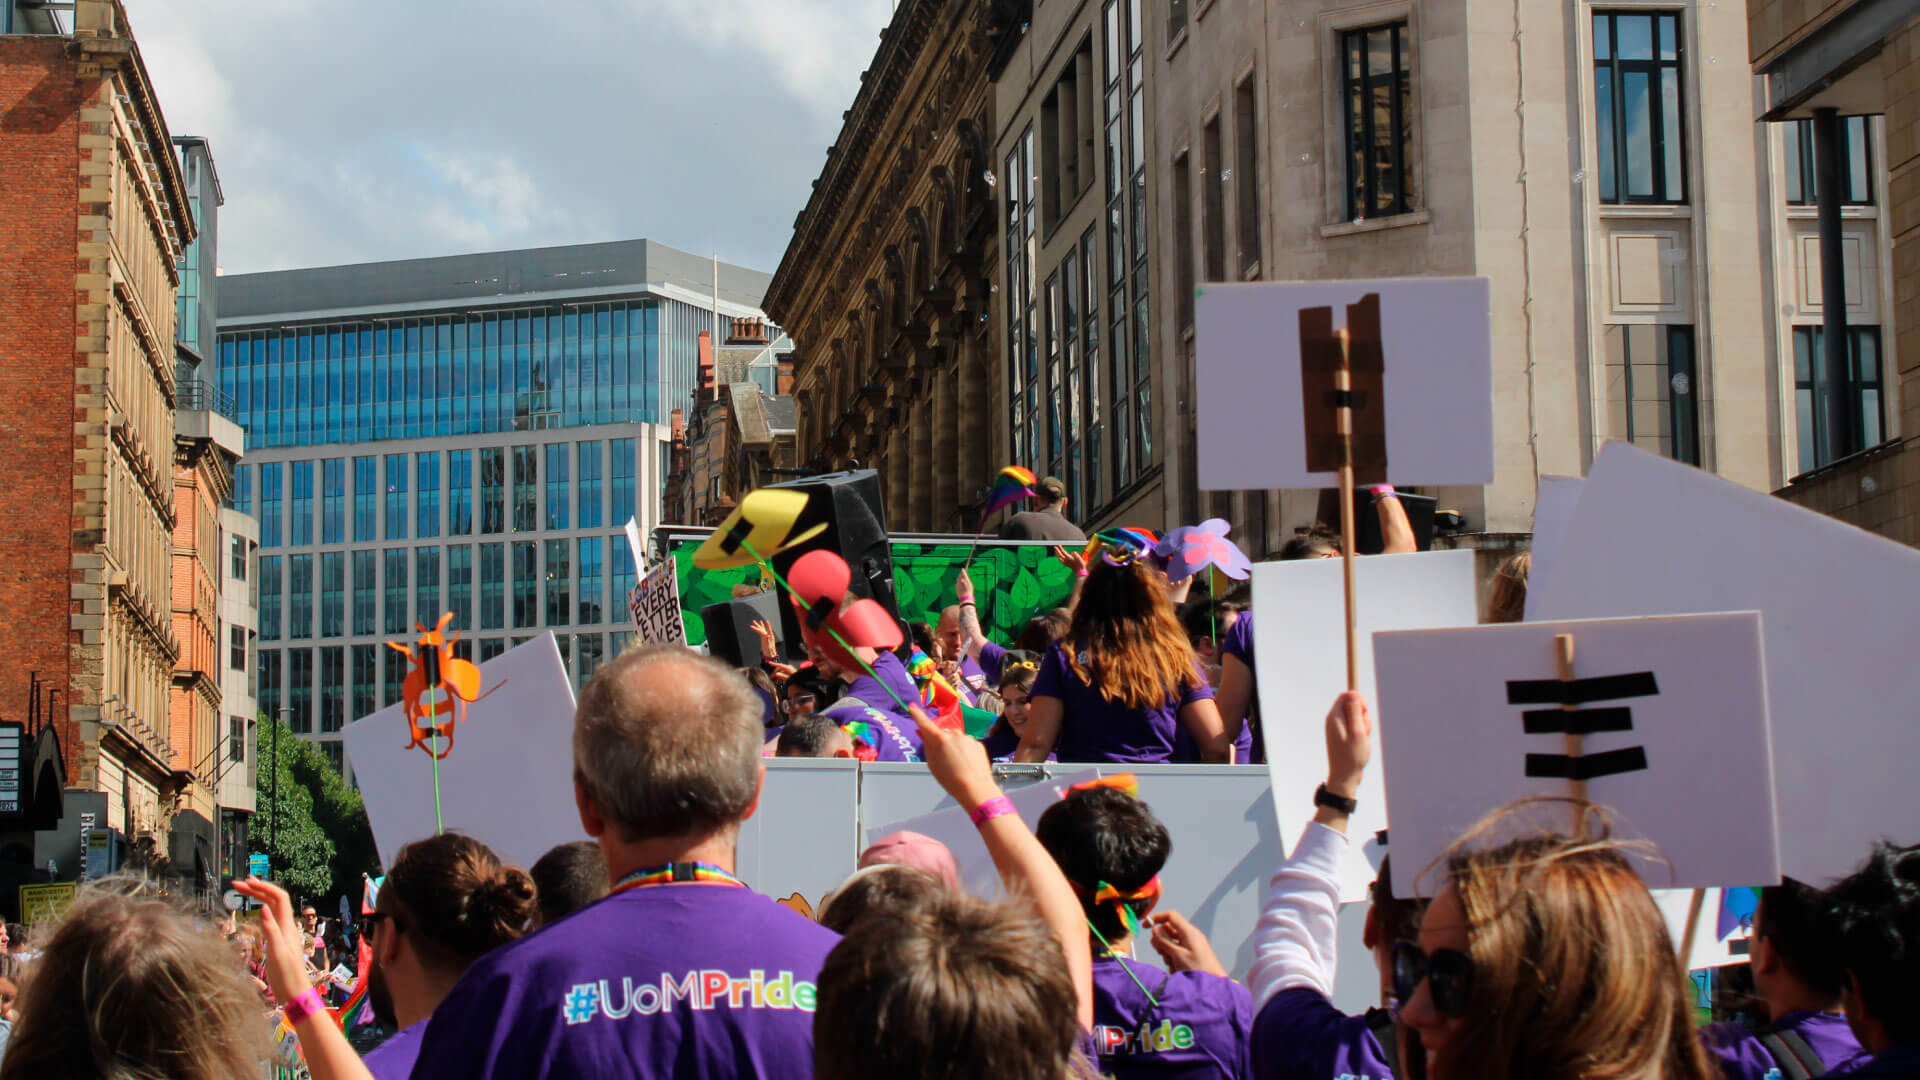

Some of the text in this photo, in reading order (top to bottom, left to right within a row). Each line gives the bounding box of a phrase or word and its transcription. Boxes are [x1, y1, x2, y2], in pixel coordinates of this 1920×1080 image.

[635, 579, 673, 626] EVERY
[635, 597, 679, 641] ETTER
[563, 969, 817, 1025] #UoMPride
